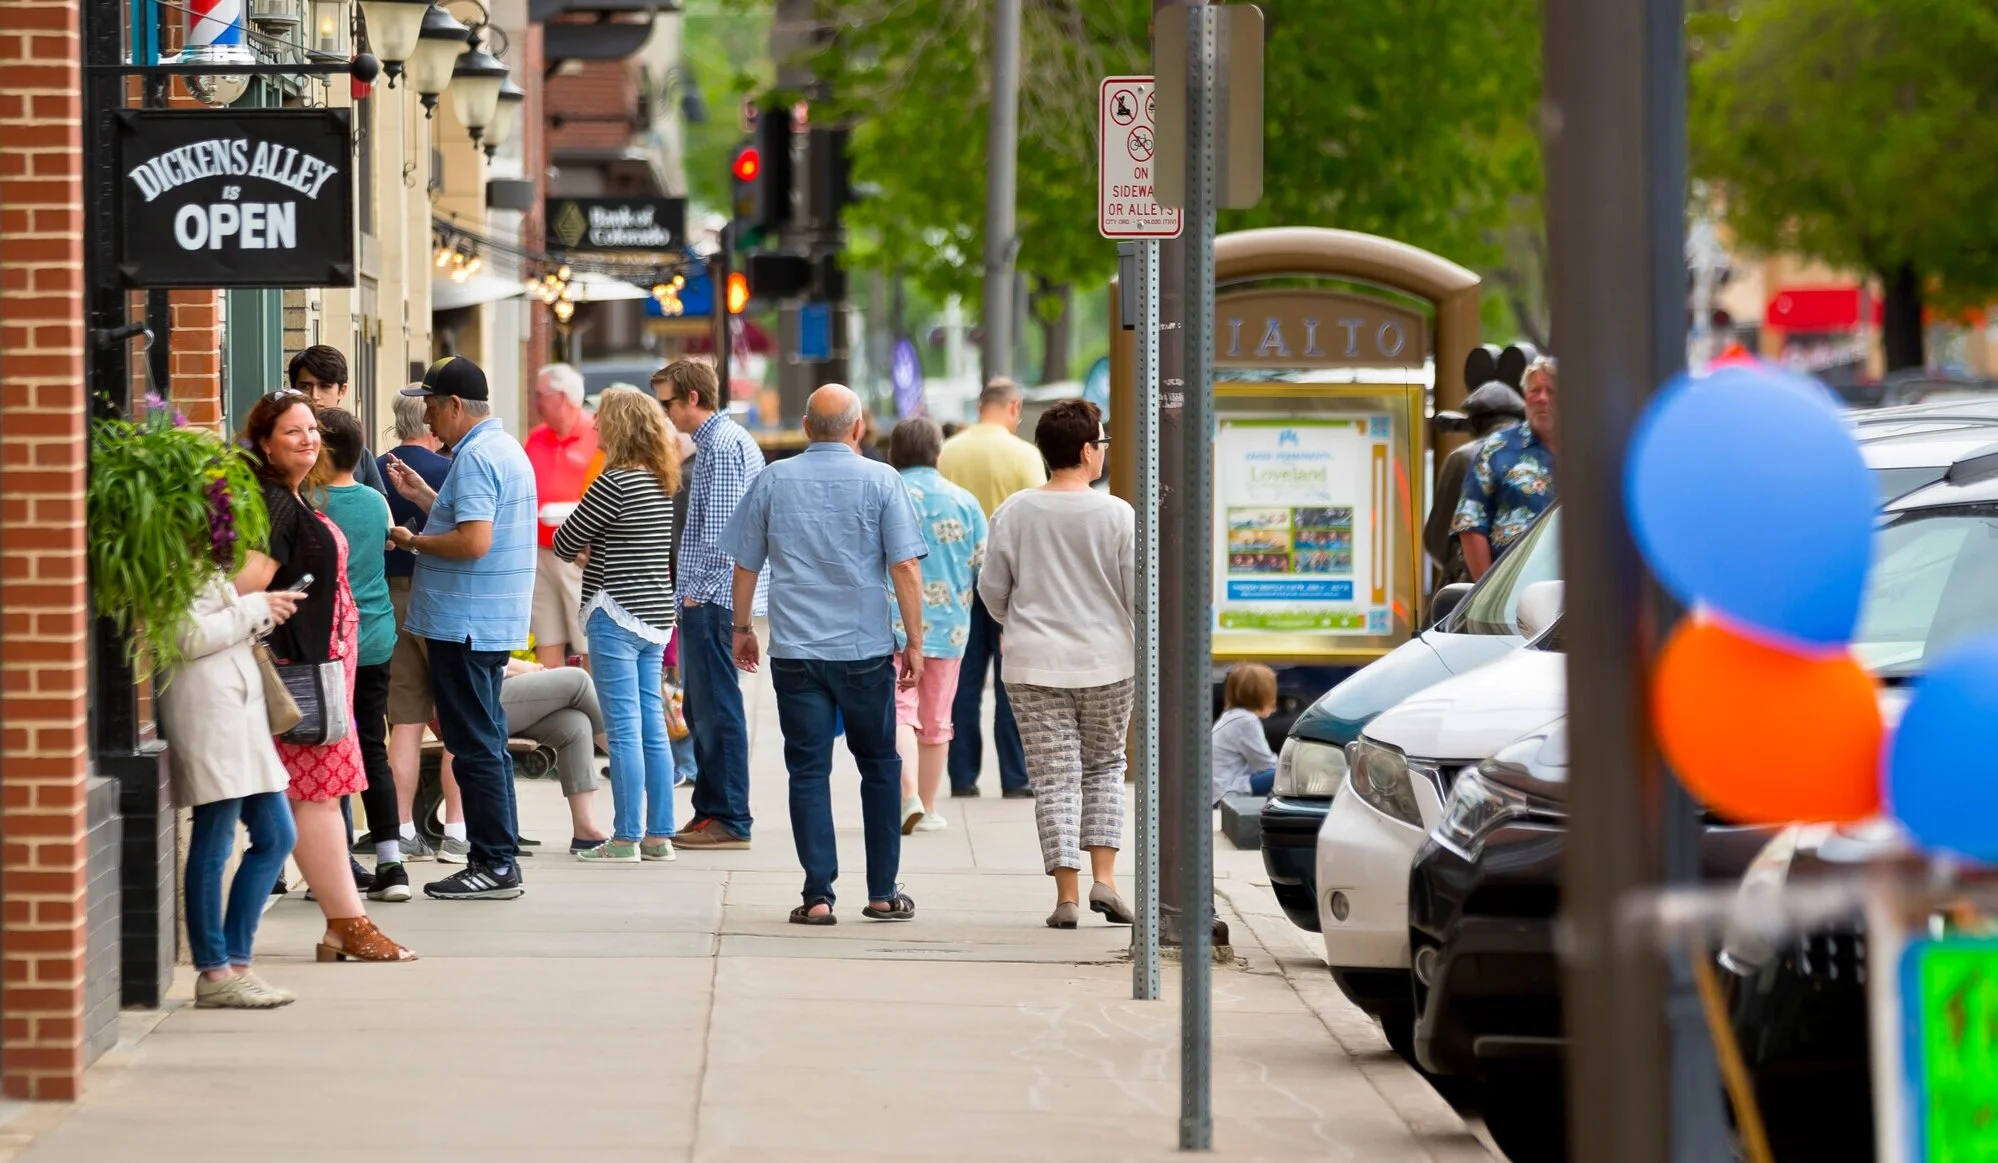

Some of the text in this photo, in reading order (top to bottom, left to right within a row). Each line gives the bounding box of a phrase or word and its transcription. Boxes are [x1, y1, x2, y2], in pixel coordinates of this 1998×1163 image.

[128, 139, 338, 202] DICKENS ALLEY
[1134, 167, 1148, 179] ON
[221, 185, 241, 200] IS
[1112, 185, 1154, 198] SIDEWA
[588, 205, 631, 228] Bank
[1108, 203, 1123, 216] OR
[174, 201, 297, 251] OPEN
[1226, 318, 1406, 357] IALTO
[1250, 466, 1328, 483] Loveland
